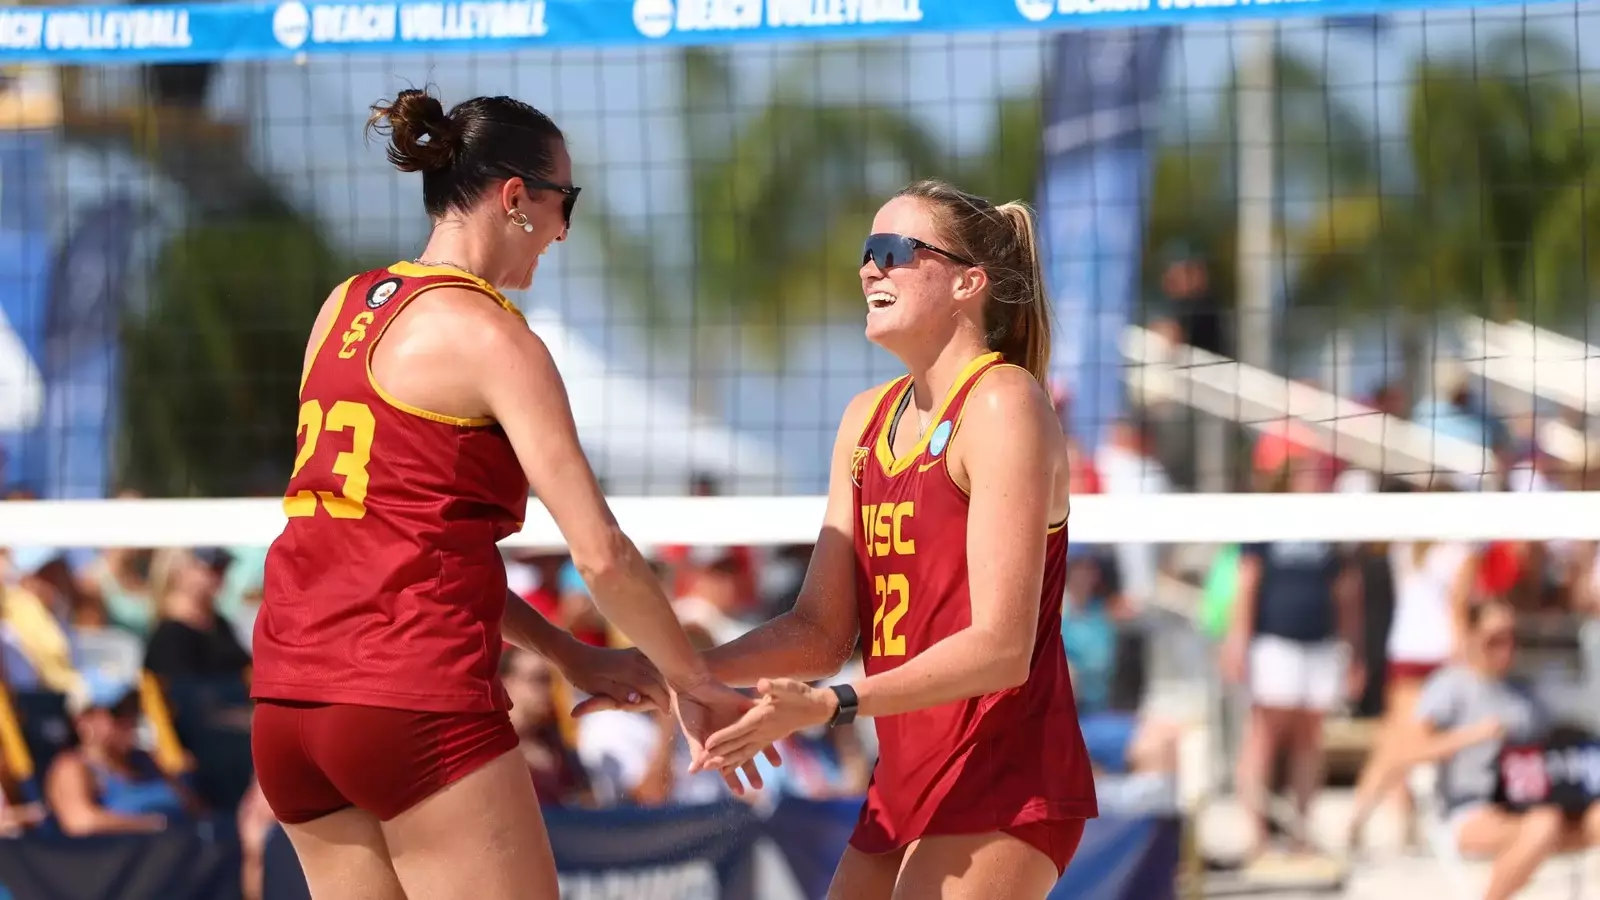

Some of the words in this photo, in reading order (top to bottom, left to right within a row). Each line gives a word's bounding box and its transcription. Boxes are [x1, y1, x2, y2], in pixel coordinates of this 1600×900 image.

[45, 9, 191, 49] VOLLEYBALL
[312, 4, 397, 43] BEACH
[400, 1, 548, 41] VOLLEYBALL
[282, 399, 376, 519] 23
[862, 501, 916, 557] USC
[871, 573, 910, 657] 22
